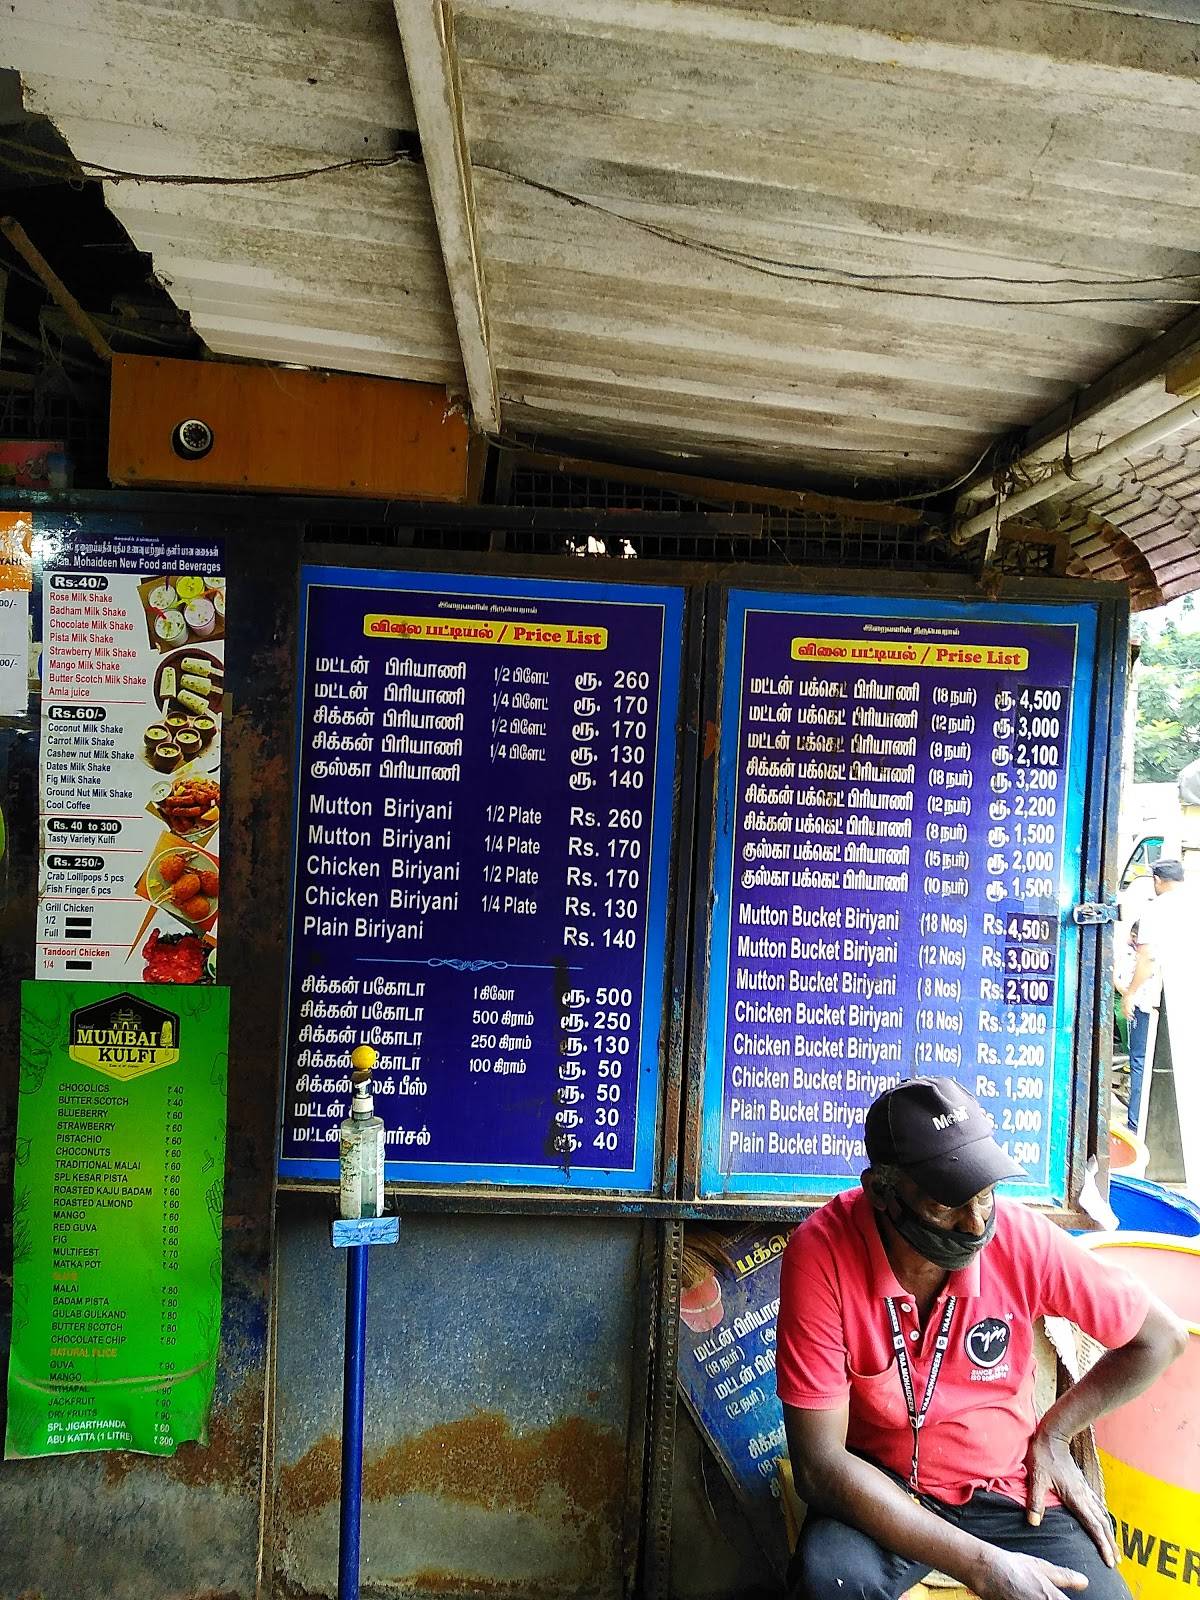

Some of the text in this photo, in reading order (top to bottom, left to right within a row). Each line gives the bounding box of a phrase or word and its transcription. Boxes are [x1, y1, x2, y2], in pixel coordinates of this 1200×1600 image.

[74, 556, 118, 569] Mohaideen
[120, 557, 137, 568] New
[139, 558, 160, 570] Food
[161, 559, 177, 571] and
[179, 560, 221, 574] Beverages
[49, 592, 113, 603] Rose Milk Shake
[49, 619, 134, 631] Chocolate Milk Shake
[370, 619, 422, 635] விலை
[426, 623, 494, 640] பட்டியல்
[513, 627, 562, 642] Price
[566, 630, 602, 645] List
[798, 643, 847, 658] விலை
[851, 645, 917, 662] பட்டியல்
[936, 648, 982, 663] Prise
[986, 650, 1021, 665] List
[49, 660, 120, 673] Mango Milk Shake
[49, 674, 147, 686] Butter Scotch Milk Shake
[315, 655, 650, 692] மட்டன் பிரியாணி 1/2 பிளேட் ரூ. 260
[48, 686, 90, 698] Amla juice
[314, 680, 648, 717] மட்டன் பிரியாணி 1/4 பிளேட் ரூ. 170
[750, 675, 794, 696] மட்டன்
[853, 678, 920, 702] பிரியாணி
[1019, 689, 1062, 713] 4,500
[52, 707, 104, 719] Rs.60/-
[48, 723, 124, 735] Coconut Milk Shake
[310, 756, 644, 791] குஸ்கா பிரியாணி ரூ. 140
[46, 800, 91, 810] Cool Coffee
[309, 794, 643, 829] Mutton Biriyani 1/2 Plate Rs. 260
[53, 820, 118, 832] Rs. 40 to 300
[48, 833, 116, 846] Tasty Variety Kulfi
[308, 825, 641, 859] Mutton Biriyani 1/4 Plate Rs. 170
[47, 872, 125, 885] Crab Lollipops 5 pcs
[306, 855, 639, 889] Chicken Biriyani 1/2 Plate Rs. 170
[45, 903, 94, 914] Grill Chicken
[305, 885, 638, 919] Chicken Biriyani 1/4 Plate Rs. 130
[44, 915, 56, 925] 1/2
[739, 903, 1050, 942] Mutton Bucket Biriyani (18 Nos) Rs. 4,500
[44, 928, 59, 938] Full
[304, 916, 636, 949] Plain Biriyani Rs. 140
[301, 975, 360, 994] சிக்கன்
[363, 976, 426, 997] பகோடா
[473, 986, 478, 1000] 1
[480, 985, 515, 1001] கிலோ
[595, 987, 632, 1007] 500
[735, 1000, 1047, 1037] Chicken Bucket Biriyani (18 Nos) Rs. 3,200
[76, 1030, 157, 1046] MUMBAI
[98, 1048, 156, 1064] KULFI
[733, 1033, 1045, 1068] Chicken Bucket Biriyani (12 Nos) Rs. 2,200
[57, 1109, 109, 1118] BLUEBERRY
[56, 1122, 116, 1131] STRAWBERRY
[56, 1134, 102, 1144] PISTACHIO
[55, 1160, 141, 1170] TRADITIONAL MALAI
[53, 1211, 86, 1220] MANGO
[53, 1223, 97, 1233] RED GUVA
[52, 1284, 79, 1294] MALAI
[47, 1419, 127, 1432] SPL JIGARTHANDA
[1108, 1511, 1200, 1588] WER
